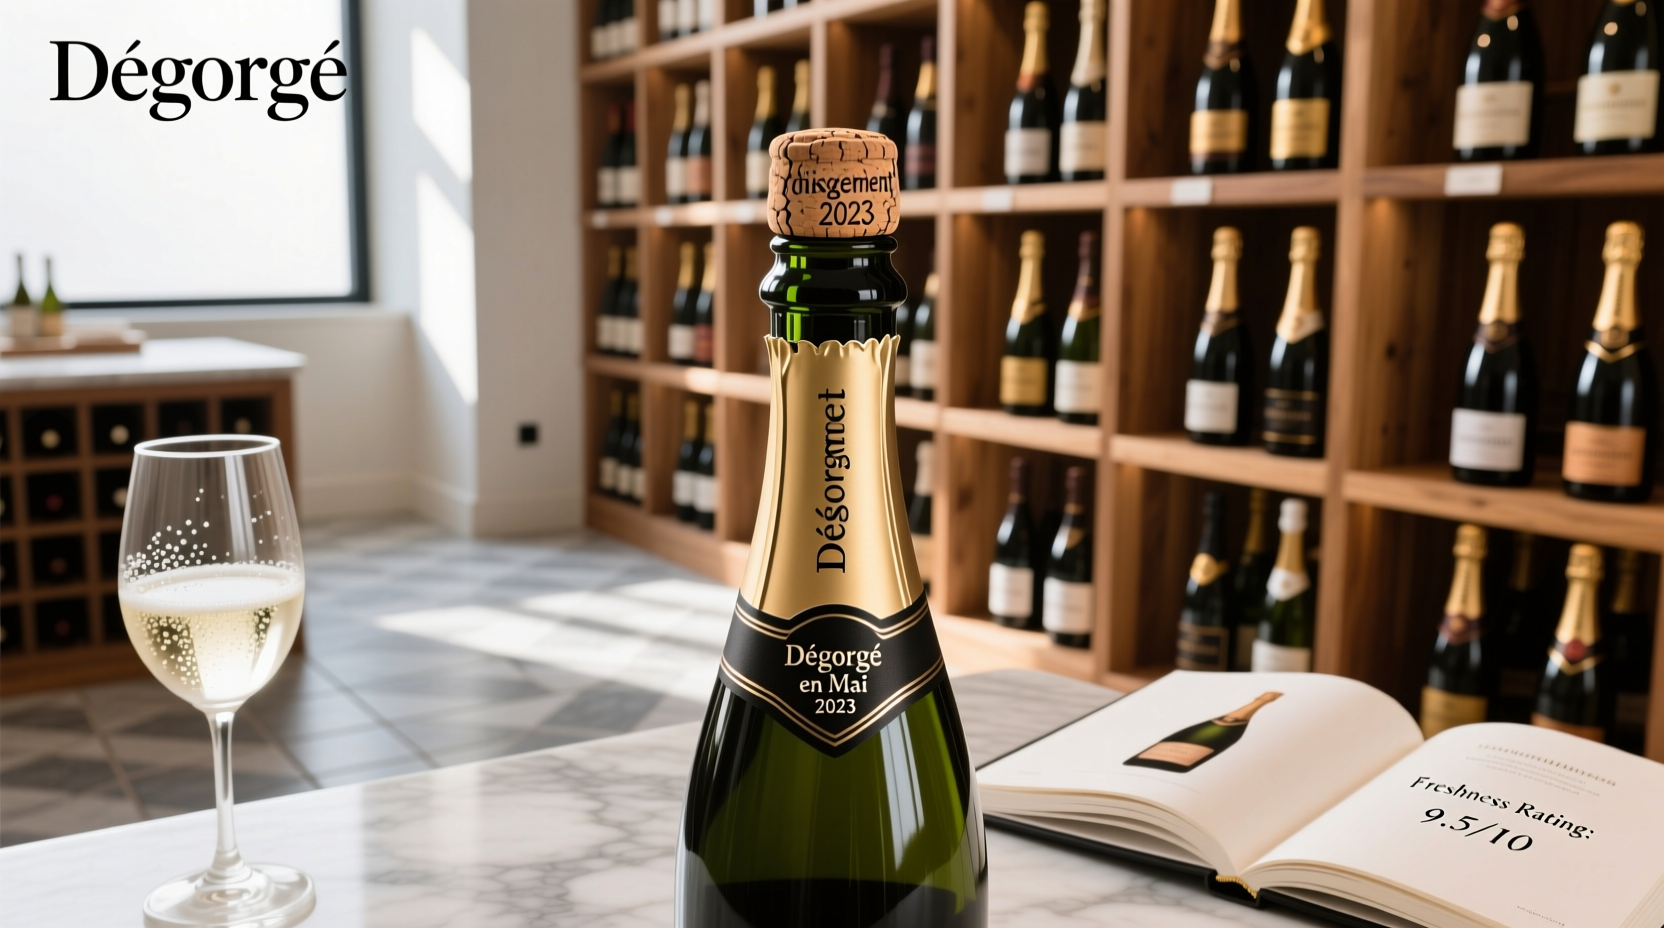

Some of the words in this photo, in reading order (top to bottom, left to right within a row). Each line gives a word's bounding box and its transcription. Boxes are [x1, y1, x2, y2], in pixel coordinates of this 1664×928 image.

[819, 200, 875, 225] 2023
[784, 643, 882, 673] Dégorgé
[800, 680, 822, 693] en
[829, 674, 868, 693] Mai
[815, 699, 856, 714] 2023
[1410, 776, 1511, 809] Freshness
[1515, 802, 1594, 839] Rating:
[1420, 808, 1534, 851] 9.5/10
